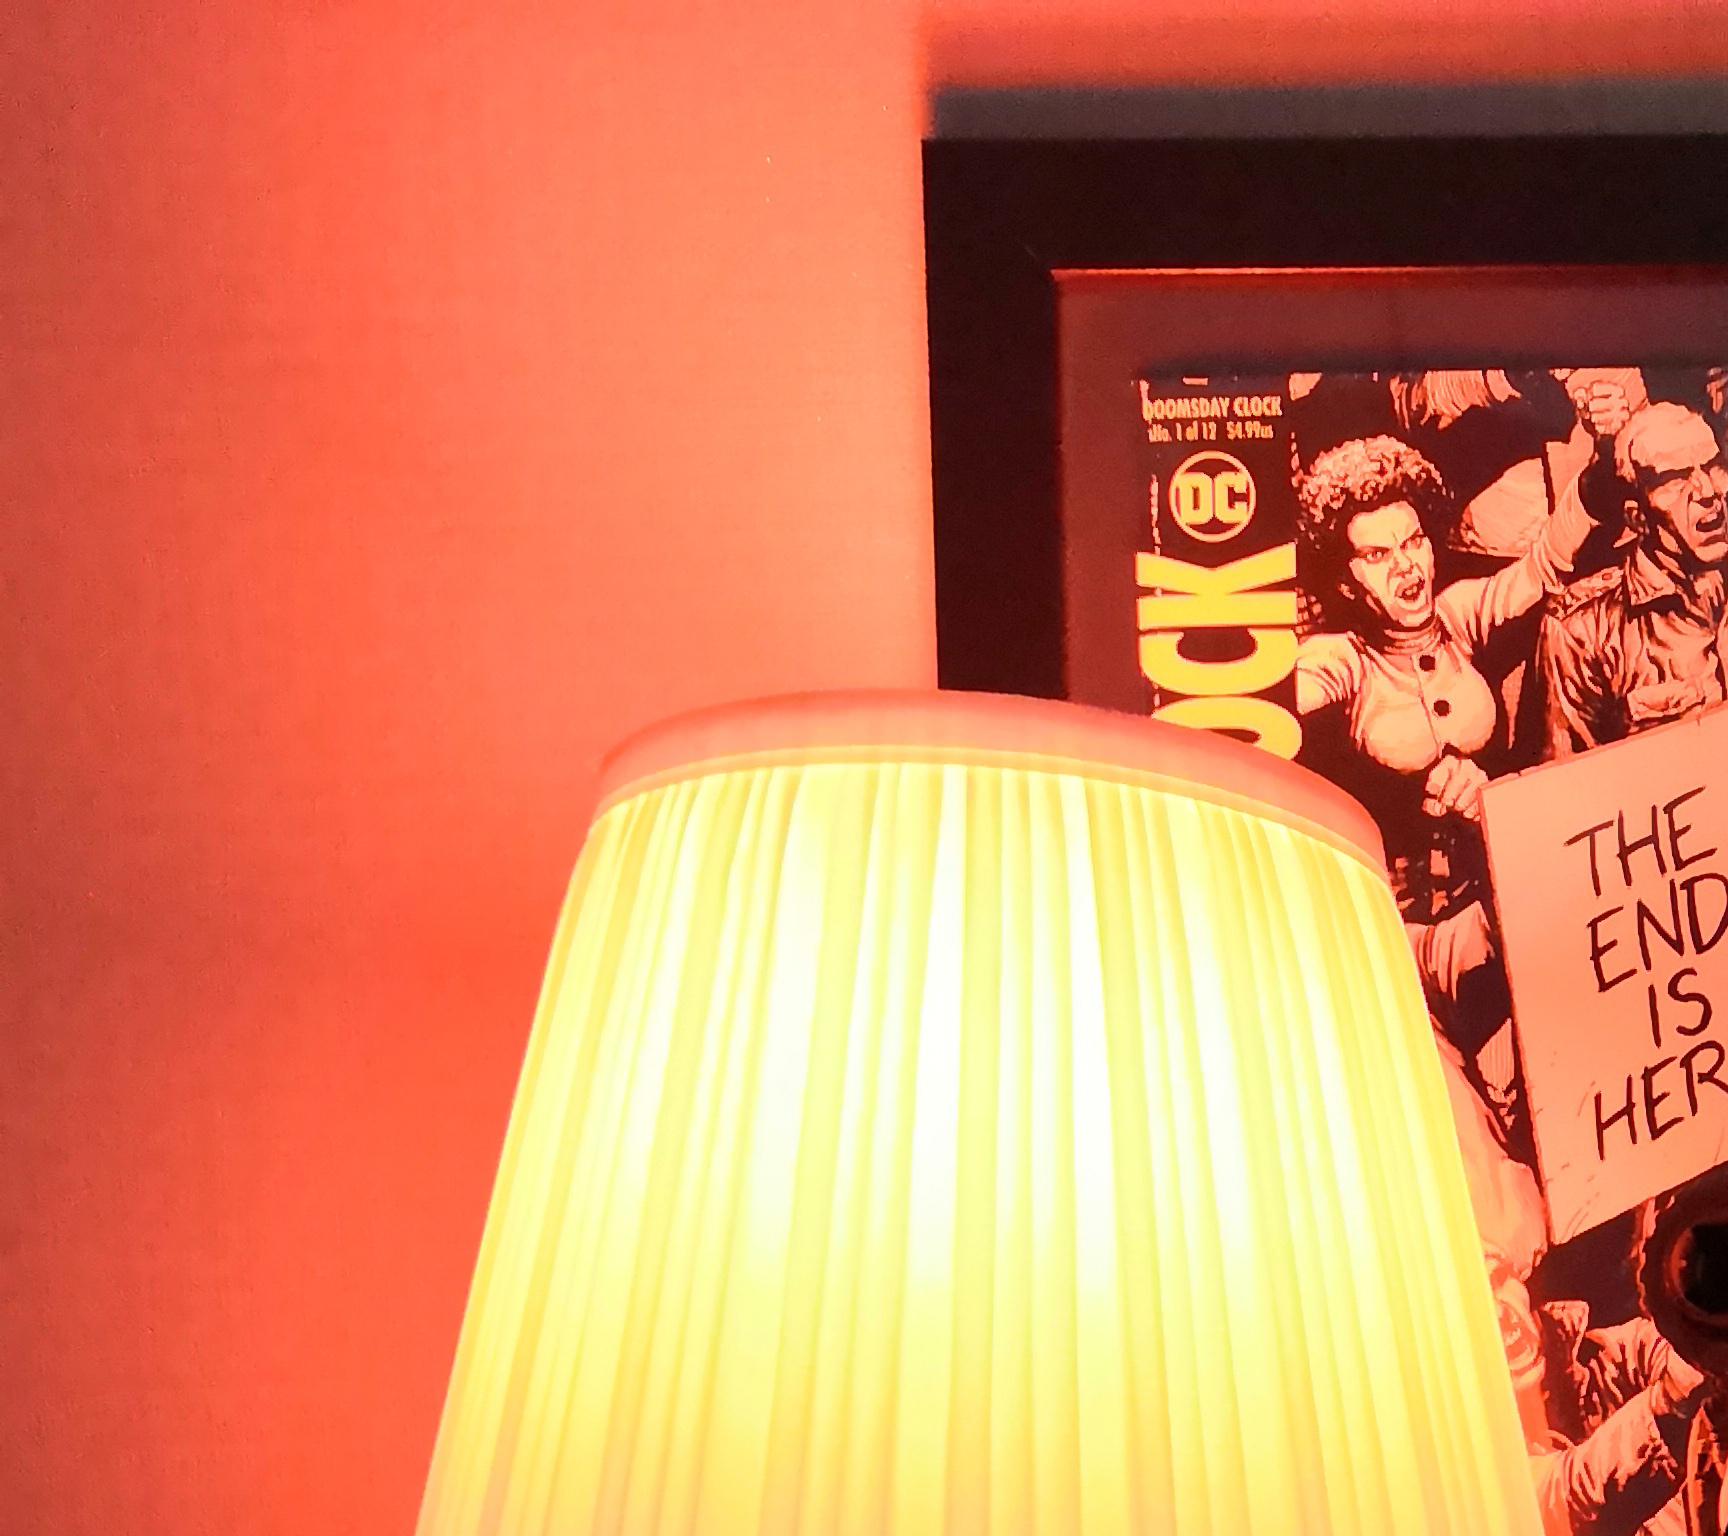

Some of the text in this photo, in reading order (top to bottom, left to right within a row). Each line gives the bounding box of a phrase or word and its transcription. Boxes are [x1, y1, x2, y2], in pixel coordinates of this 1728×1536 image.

[1143, 395, 1282, 420] DOOMSDAY CLOCK
[1202, 422, 1217, 441] 12
[1178, 471, 1248, 525] DC
[1564, 785, 1718, 897] THE
[1647, 966, 1714, 1048] IS
